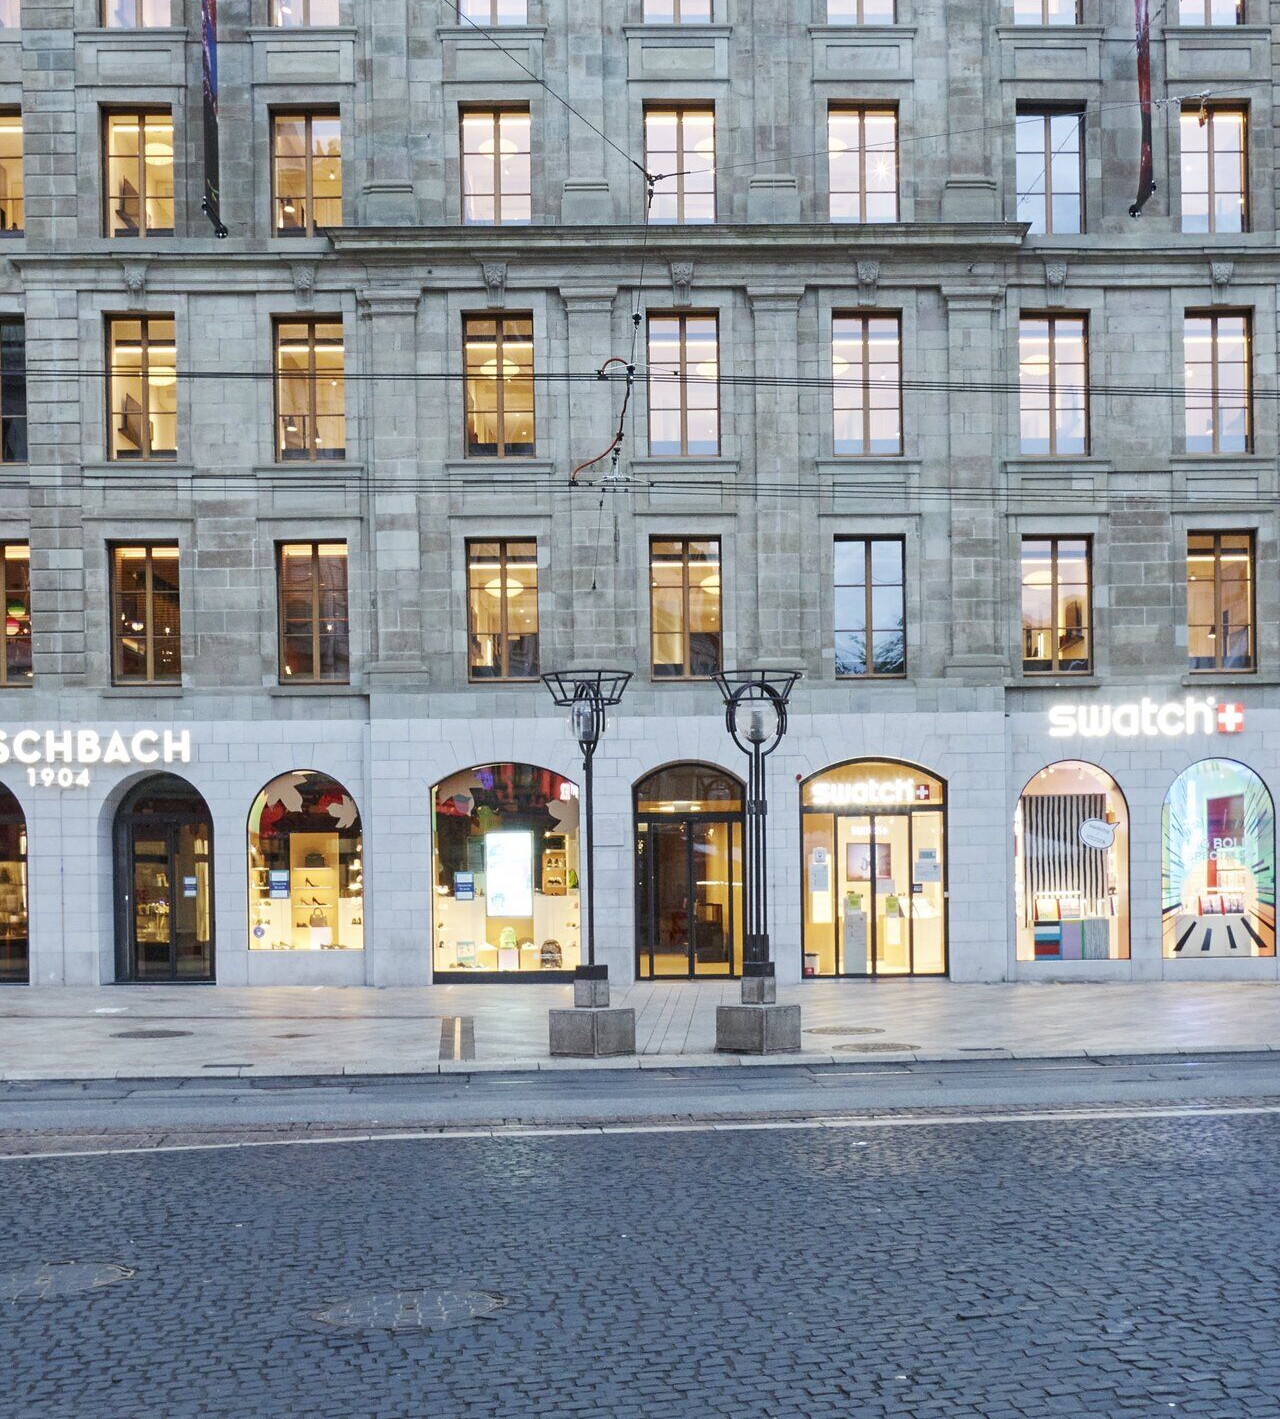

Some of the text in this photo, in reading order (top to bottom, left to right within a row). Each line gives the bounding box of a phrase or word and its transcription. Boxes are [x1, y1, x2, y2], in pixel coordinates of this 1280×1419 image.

[1049, 697, 1216, 737] swatch
[27, 767, 90, 788] 1904
[811, 779, 914, 805] swatch
